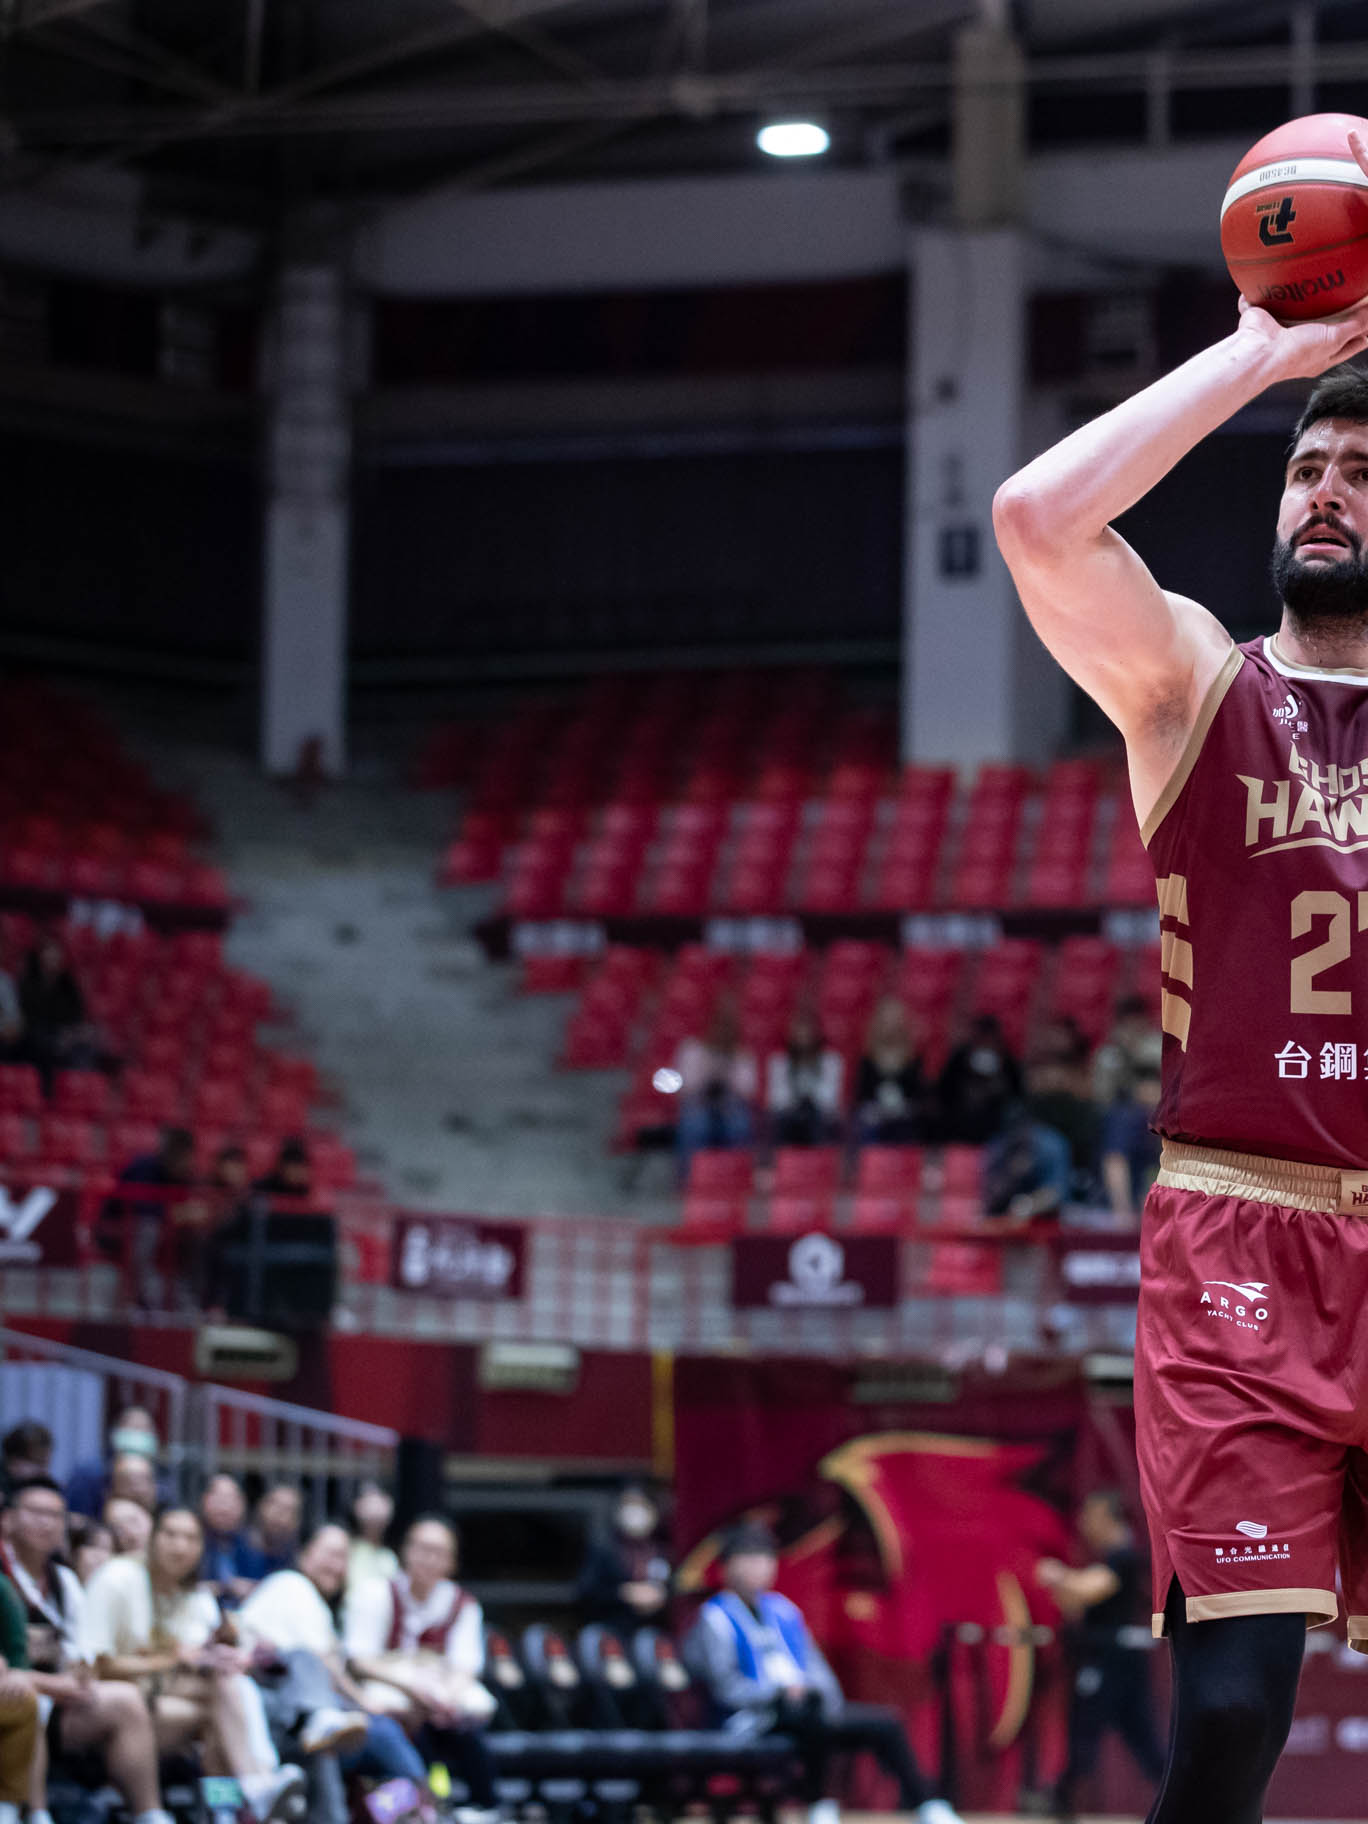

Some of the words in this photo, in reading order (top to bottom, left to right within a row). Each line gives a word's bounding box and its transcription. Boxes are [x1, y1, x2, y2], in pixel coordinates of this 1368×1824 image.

[1258, 269, 1345, 302] molten
[1200, 1291, 1269, 1321] ARGO
[1207, 1309, 1234, 1322] YACHT
[1236, 1320, 1261, 1331] CLUB
[1233, 1553, 1291, 1563] COMMUNICATION
